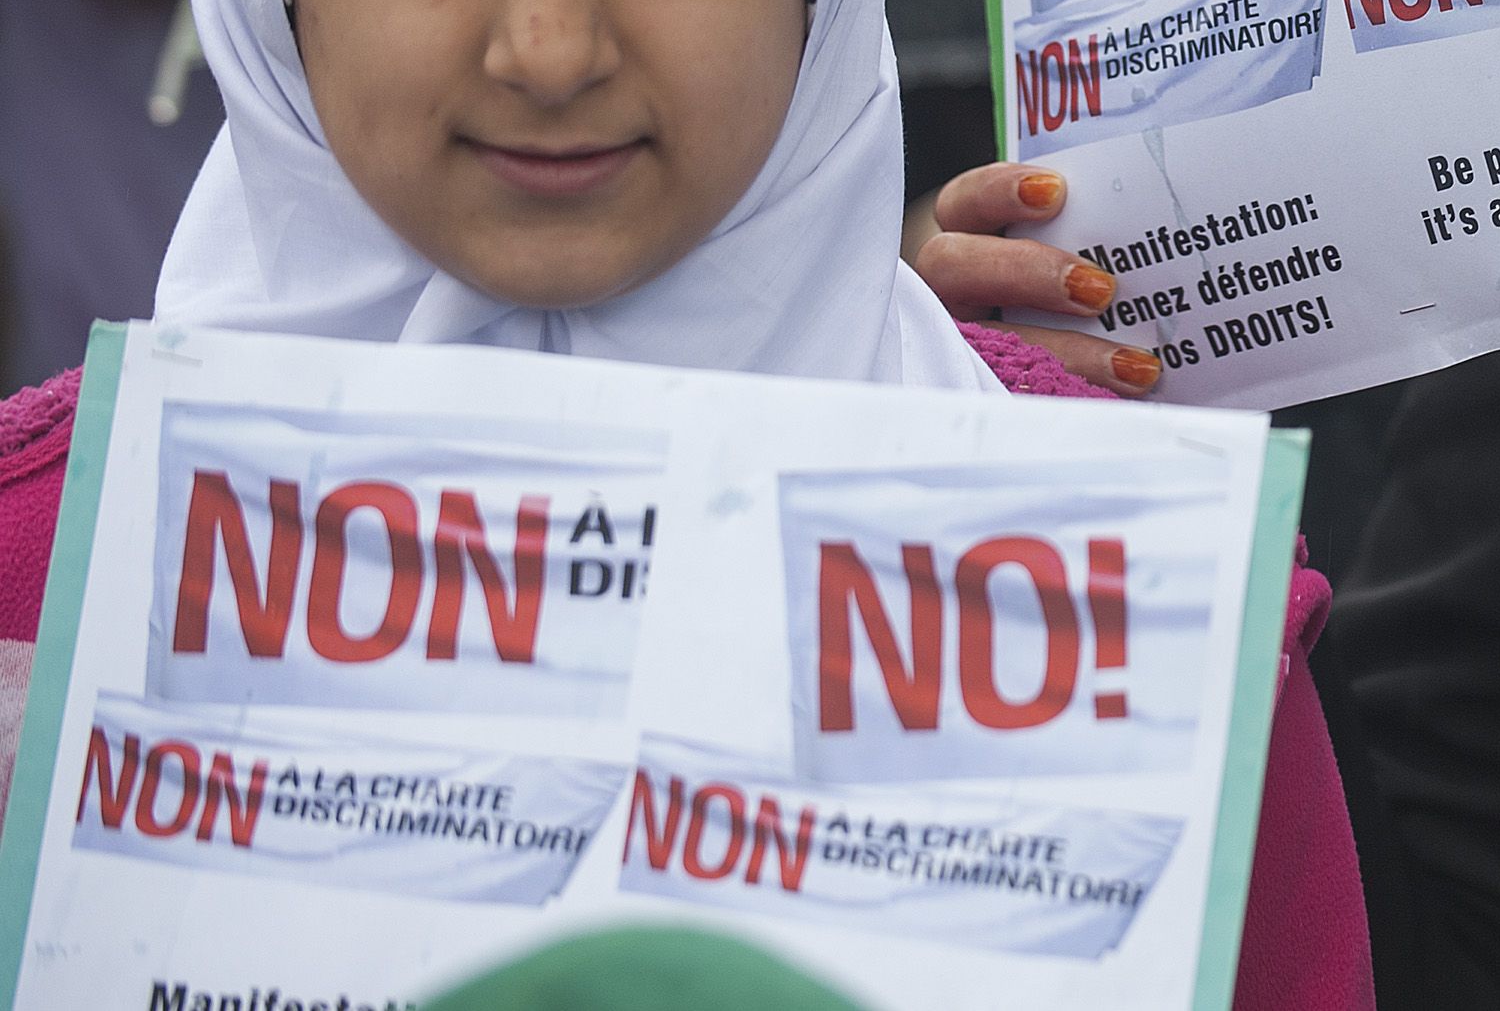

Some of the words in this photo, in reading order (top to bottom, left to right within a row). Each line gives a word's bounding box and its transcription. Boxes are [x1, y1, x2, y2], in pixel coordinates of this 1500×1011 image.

[1104, 27, 1118, 55] À
[1125, 23, 1155, 50] LA
[1016, 34, 1102, 140] NON
[1427, 155, 1474, 192] Be
[1420, 203, 1479, 245] it's
[1197, 243, 1342, 306] défendre
[1203, 296, 1334, 358] DROITS!
[172, 468, 550, 665] NON
[569, 557, 649, 600] DI
[817, 533, 1130, 734] NO!
[76, 725, 268, 848] NON
[314, 767, 356, 796] LA
[370, 774, 517, 812] CHARTE
[622, 767, 818, 893] NON
[921, 824, 1067, 864] CHARTE
